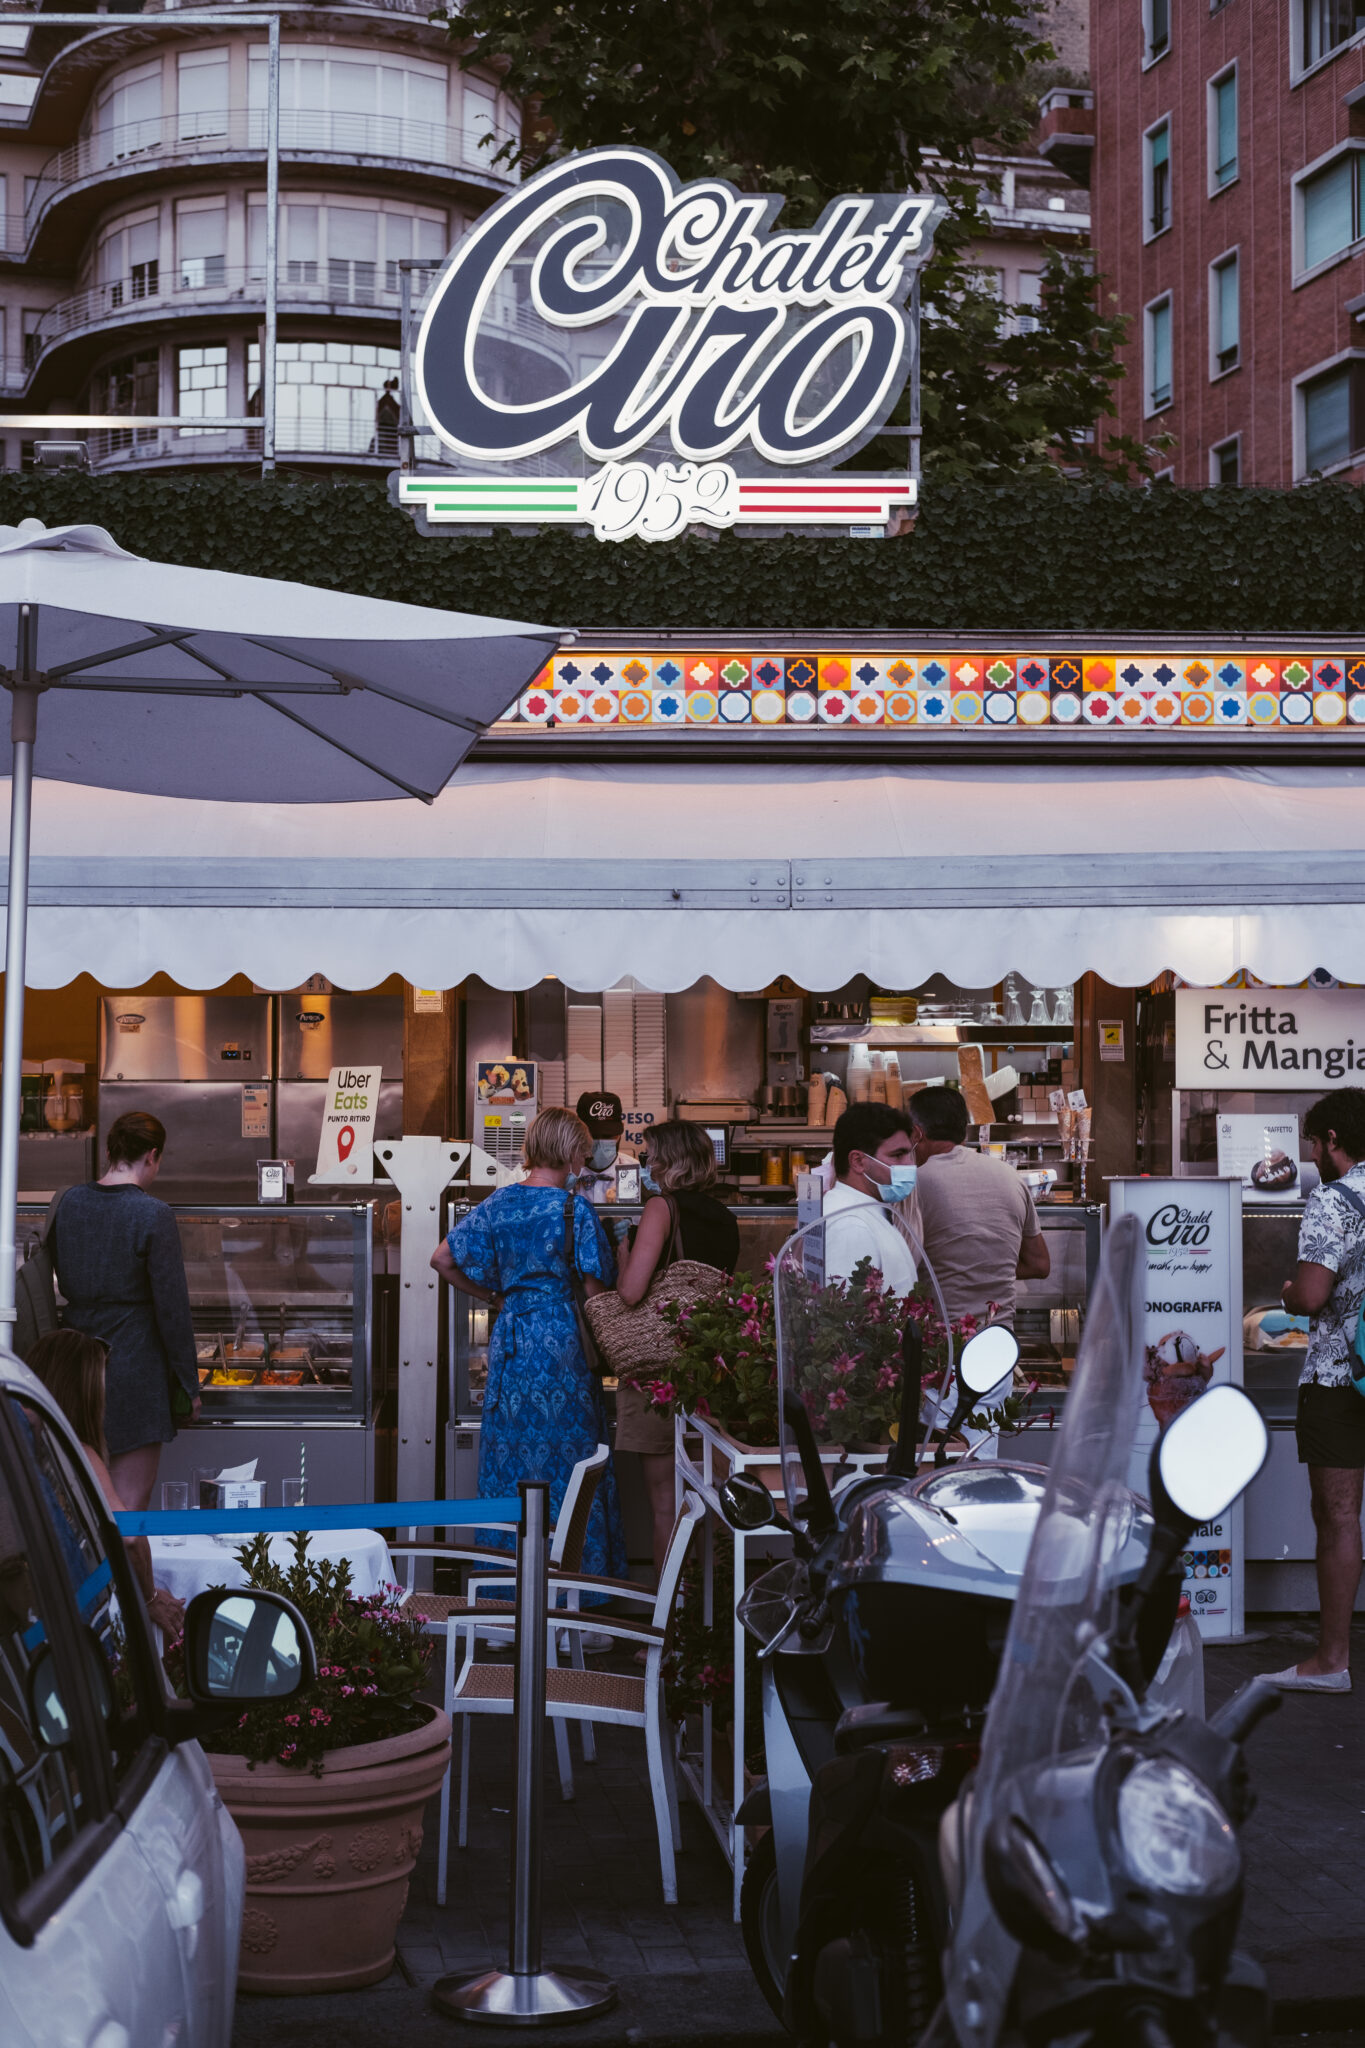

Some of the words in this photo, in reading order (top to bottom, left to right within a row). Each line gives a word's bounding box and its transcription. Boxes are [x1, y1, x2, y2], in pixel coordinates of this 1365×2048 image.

[658, 188, 926, 299] Chalet
[419, 154, 901, 458] Ciro
[590, 467, 732, 534] 1952
[1204, 1003, 1298, 1035] Fritta
[1203, 1039, 1230, 1070] &
[337, 1070, 372, 1089] Uber
[334, 1091, 368, 1110] Eats
[327, 1115, 349, 1123] PUNTO
[625, 1130, 643, 1145] kg
[1146, 1204, 1210, 1246] Ciro
[1177, 1209, 1212, 1223] Chalet
[1144, 1301, 1223, 1313] ONOGRAFFA
